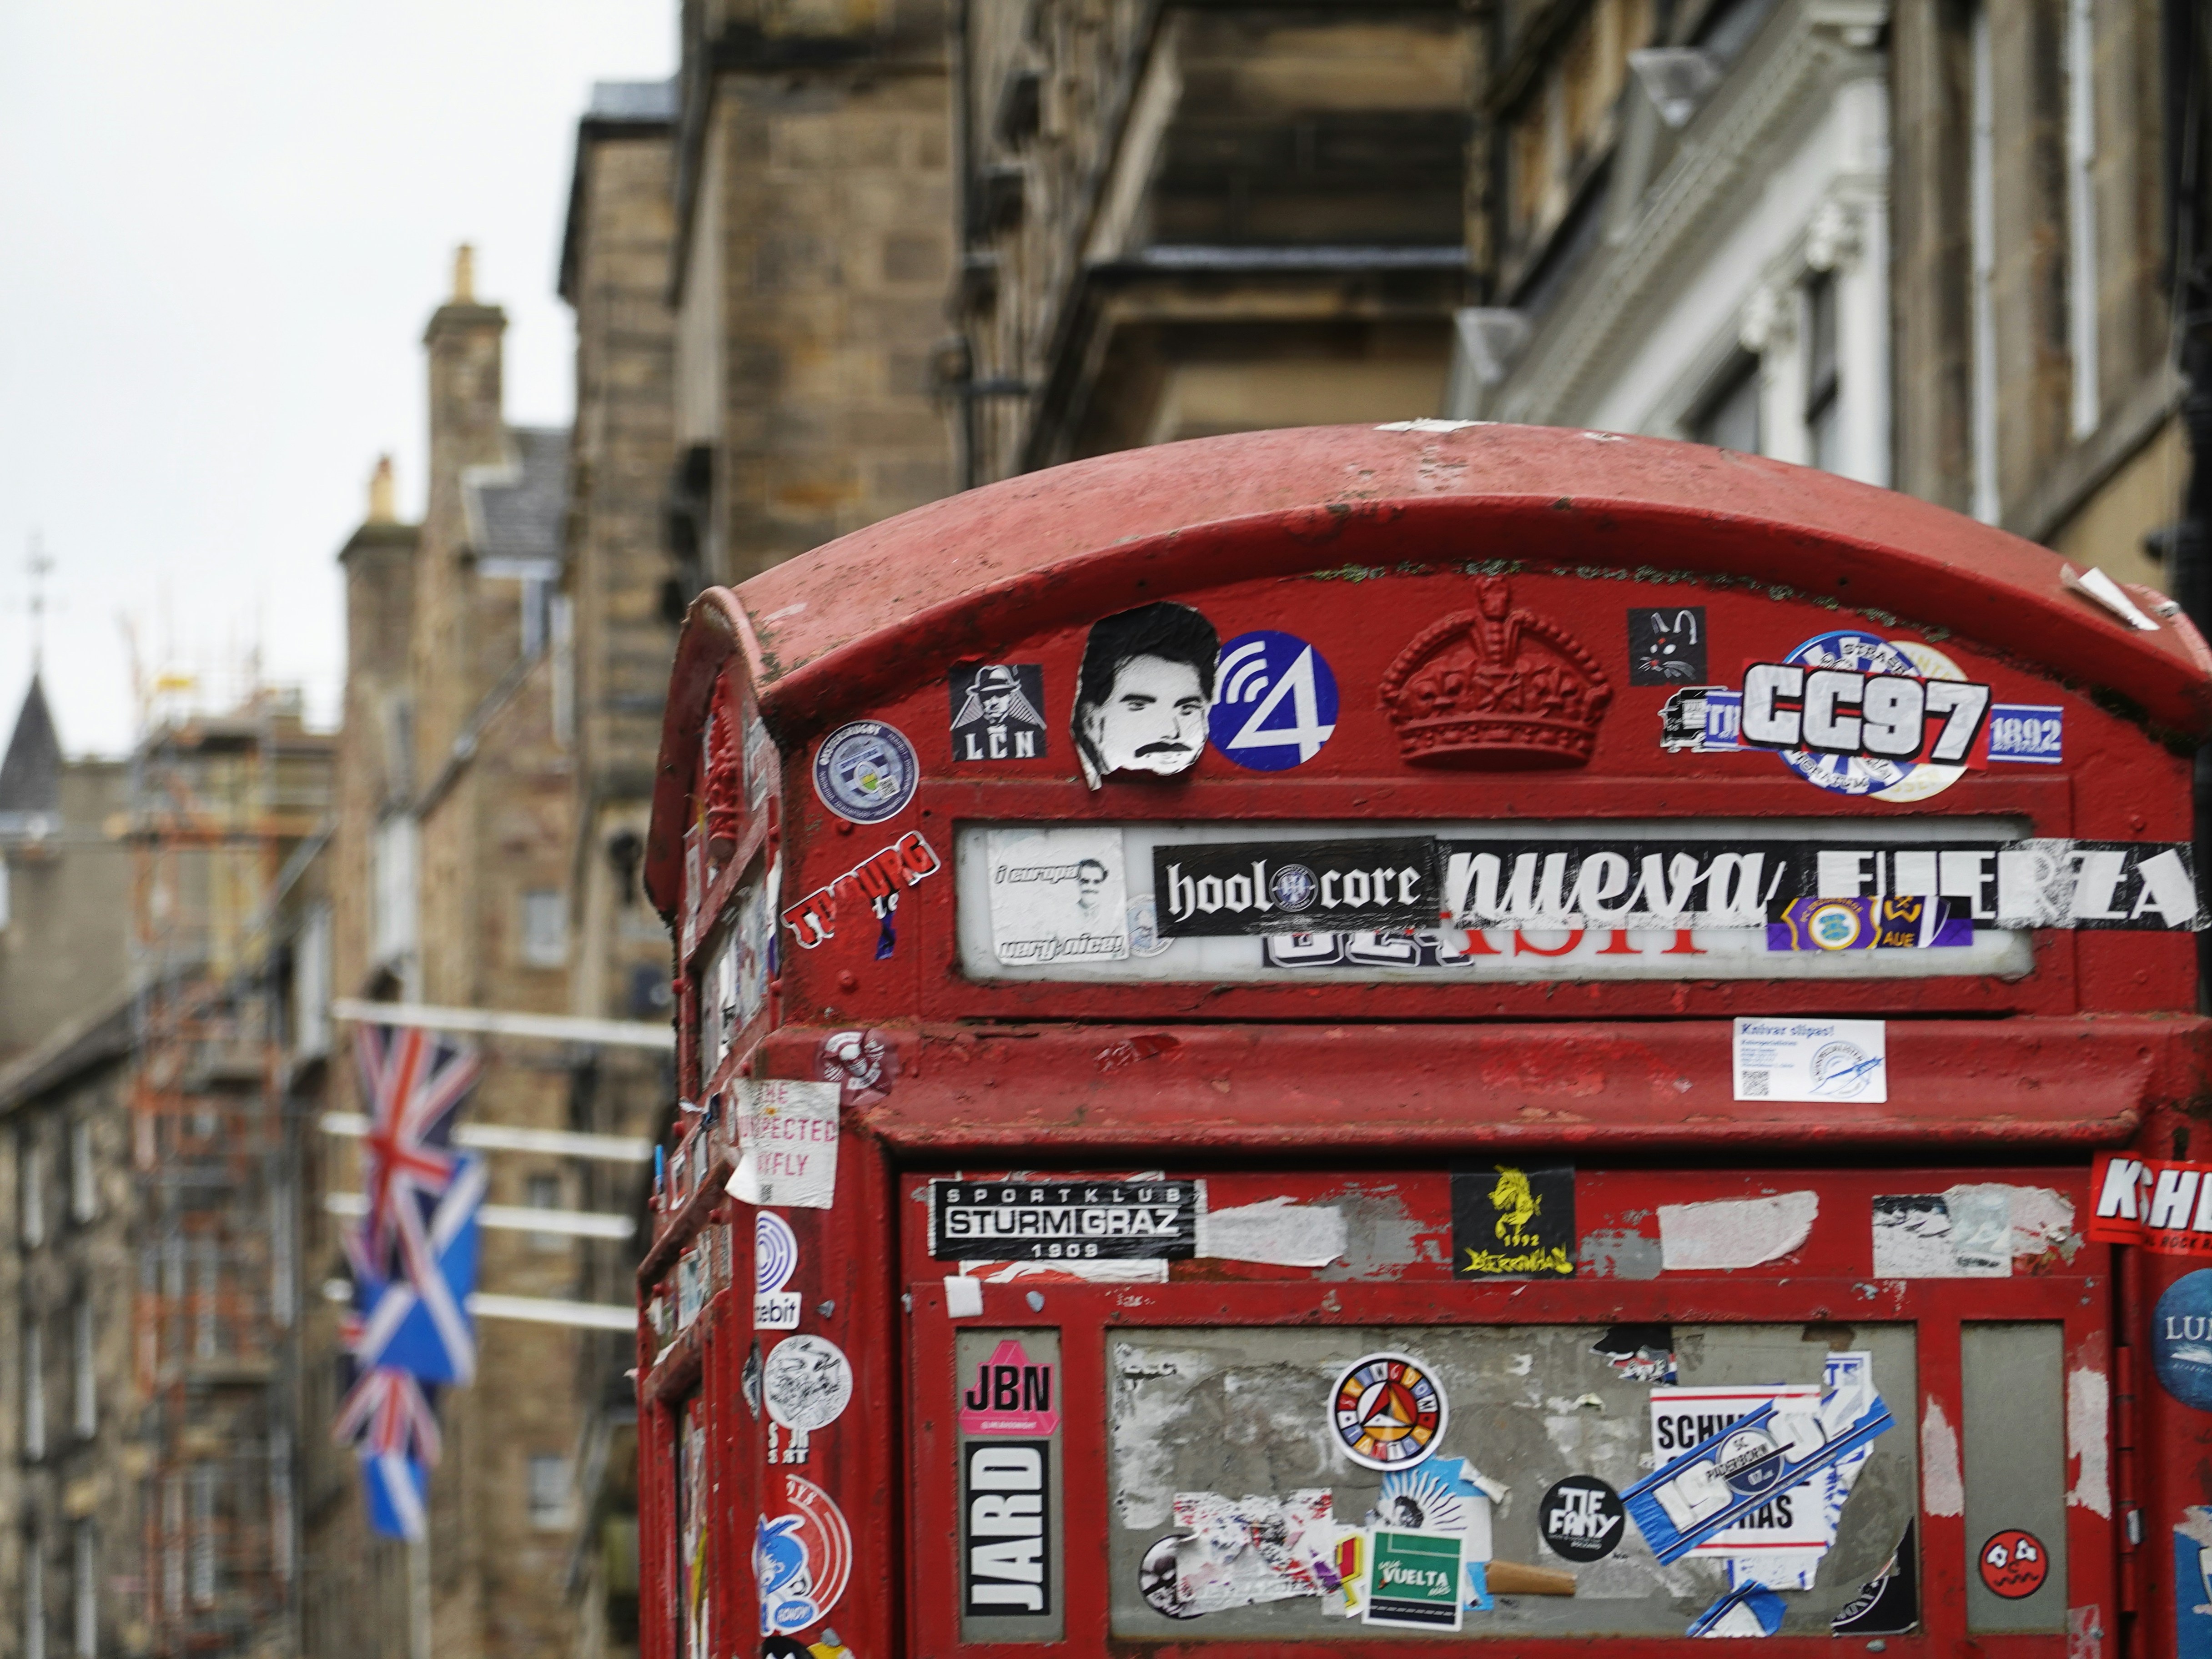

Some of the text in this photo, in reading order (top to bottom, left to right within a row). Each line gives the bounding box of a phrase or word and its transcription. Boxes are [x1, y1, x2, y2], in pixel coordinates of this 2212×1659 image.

[1226, 644, 1336, 764] 4
[1744, 663, 1989, 762] CC97
[965, 730, 1035, 760] LCN
[1990, 717, 2062, 752] 1892
[1166, 859, 1422, 923] hool core
[1445, 851, 1786, 920] nueva
[1882, 931, 1915, 948] AUE
[946, 1188, 1181, 1203] SPORTKLUB
[950, 1208, 1180, 1235] STURM GRAZ
[1031, 1243, 1099, 1258] 1909
[967, 1365, 1050, 1412] JBN
[970, 1447, 1044, 1612] JARD
[1382, 1568, 1449, 1587] VUELTA
